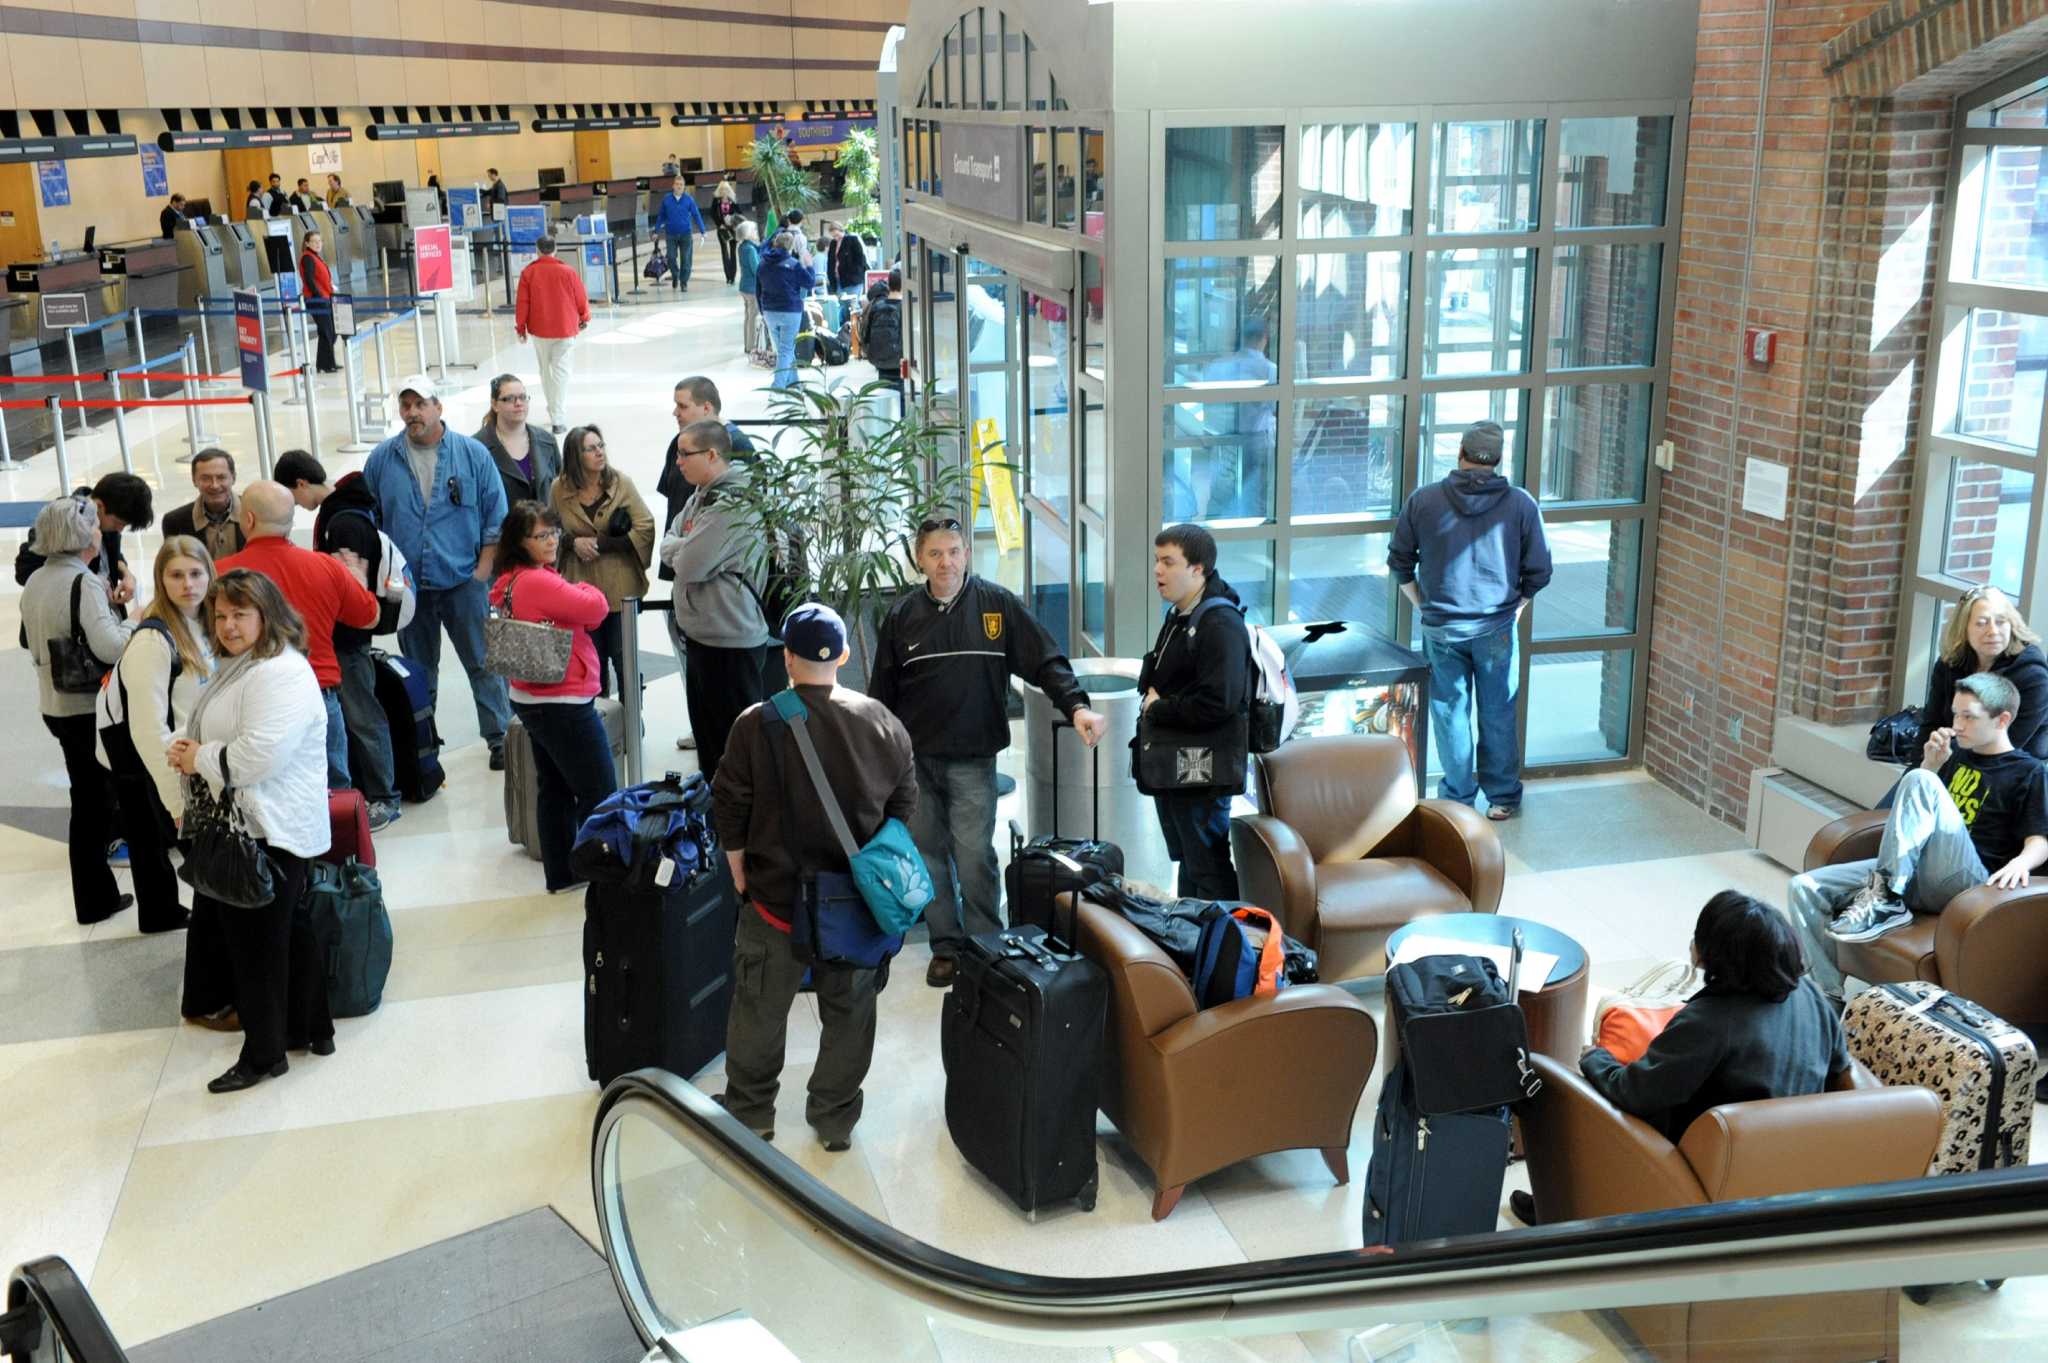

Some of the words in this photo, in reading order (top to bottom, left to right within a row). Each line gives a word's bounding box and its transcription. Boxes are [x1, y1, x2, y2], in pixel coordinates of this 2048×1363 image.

[953, 153, 970, 176] Ground
[970, 155, 993, 183] Transport
[1949, 765, 1981, 797] NO
